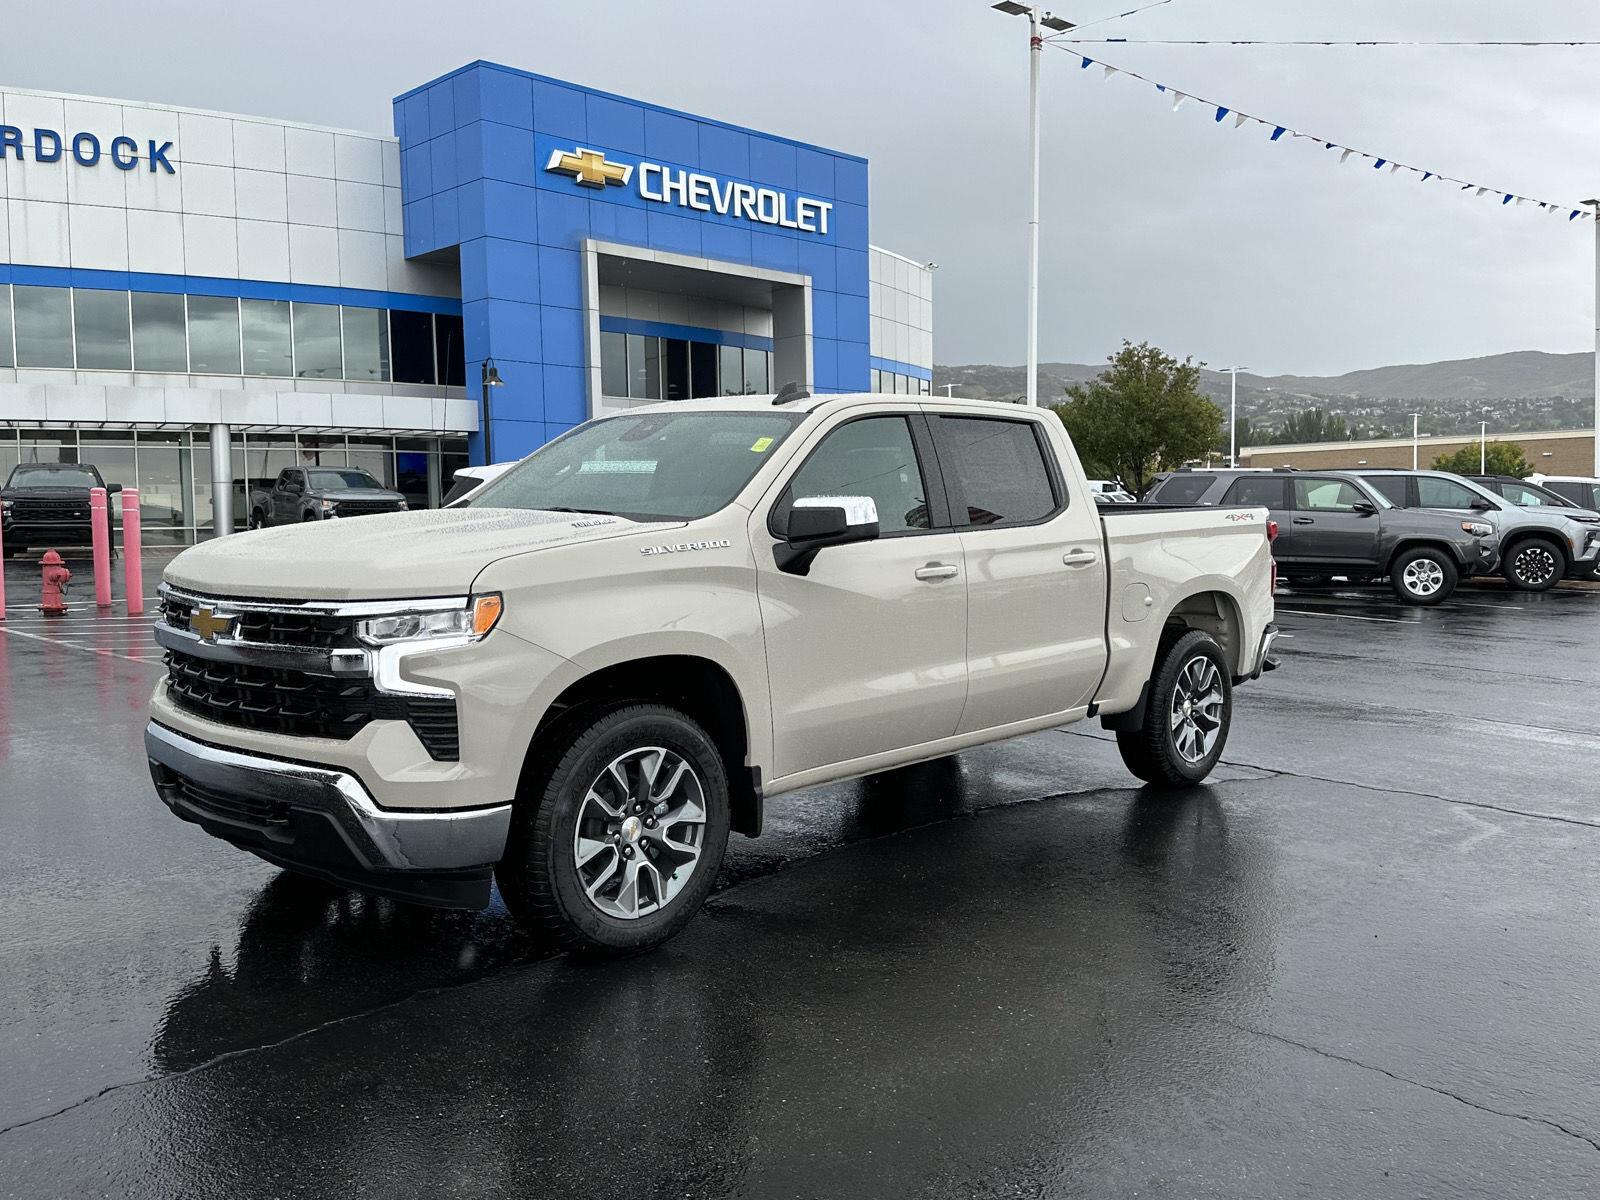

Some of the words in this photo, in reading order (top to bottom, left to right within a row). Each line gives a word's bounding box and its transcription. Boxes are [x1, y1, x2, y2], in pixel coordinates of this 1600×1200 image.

[0, 125, 175, 174] RDOCK
[639, 162, 833, 234] CHEVROLET
[640, 540, 730, 556] SILVERADO
